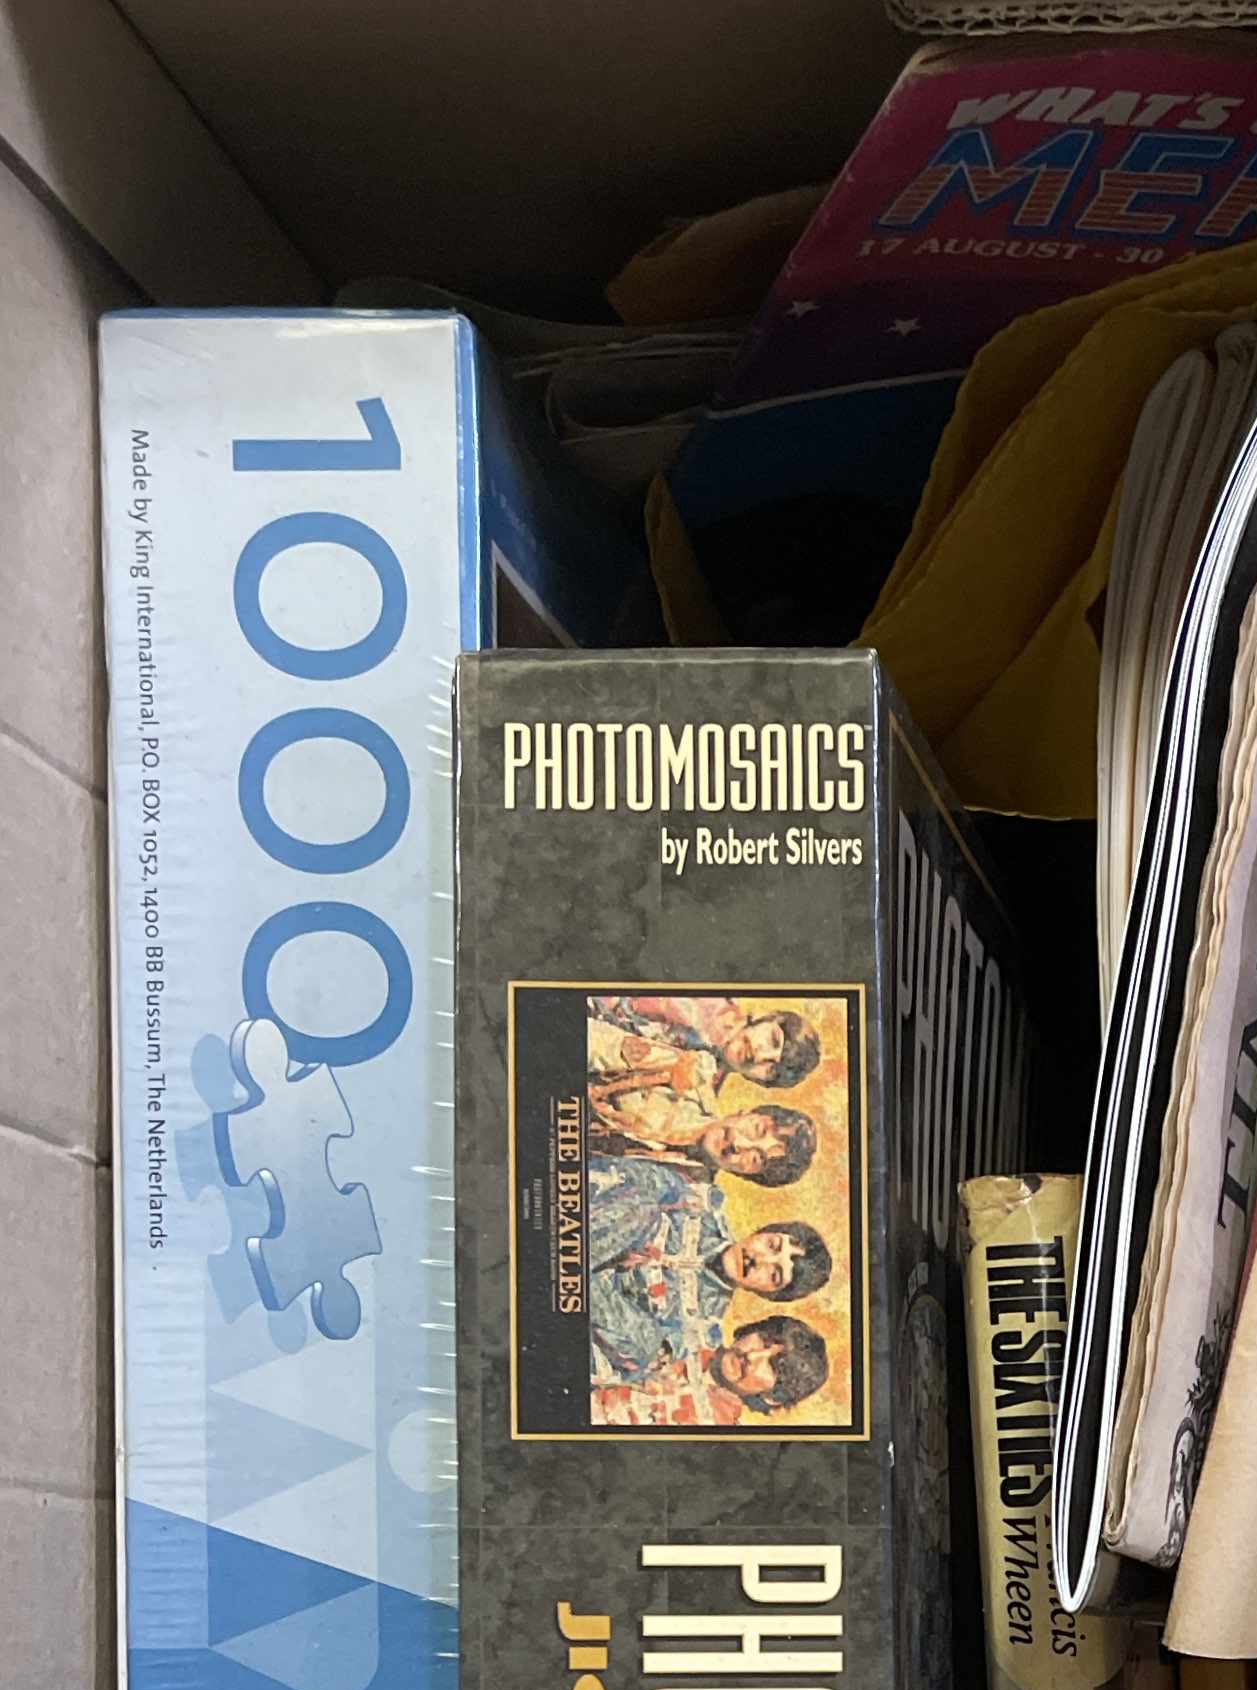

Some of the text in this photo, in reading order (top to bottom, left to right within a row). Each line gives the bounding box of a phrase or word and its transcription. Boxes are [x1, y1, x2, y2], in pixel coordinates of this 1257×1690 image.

[950, 87, 1243, 129] WHAT'S
[858, 239, 1165, 264] 17 AUGUST 30
[233, 398, 412, 1067] 1000
[127, 429, 169, 1249] Made by King International, P.O. BOX 1052, 1400 BB Bussum, The Netherlands
[661, 827, 863, 876] by Robert Silvers
[556, 1095, 582, 1313] THE BEATLES
[986, 1235, 1068, 1509] THE SIXTIES
[1002, 1515, 1040, 1645] Wheen
